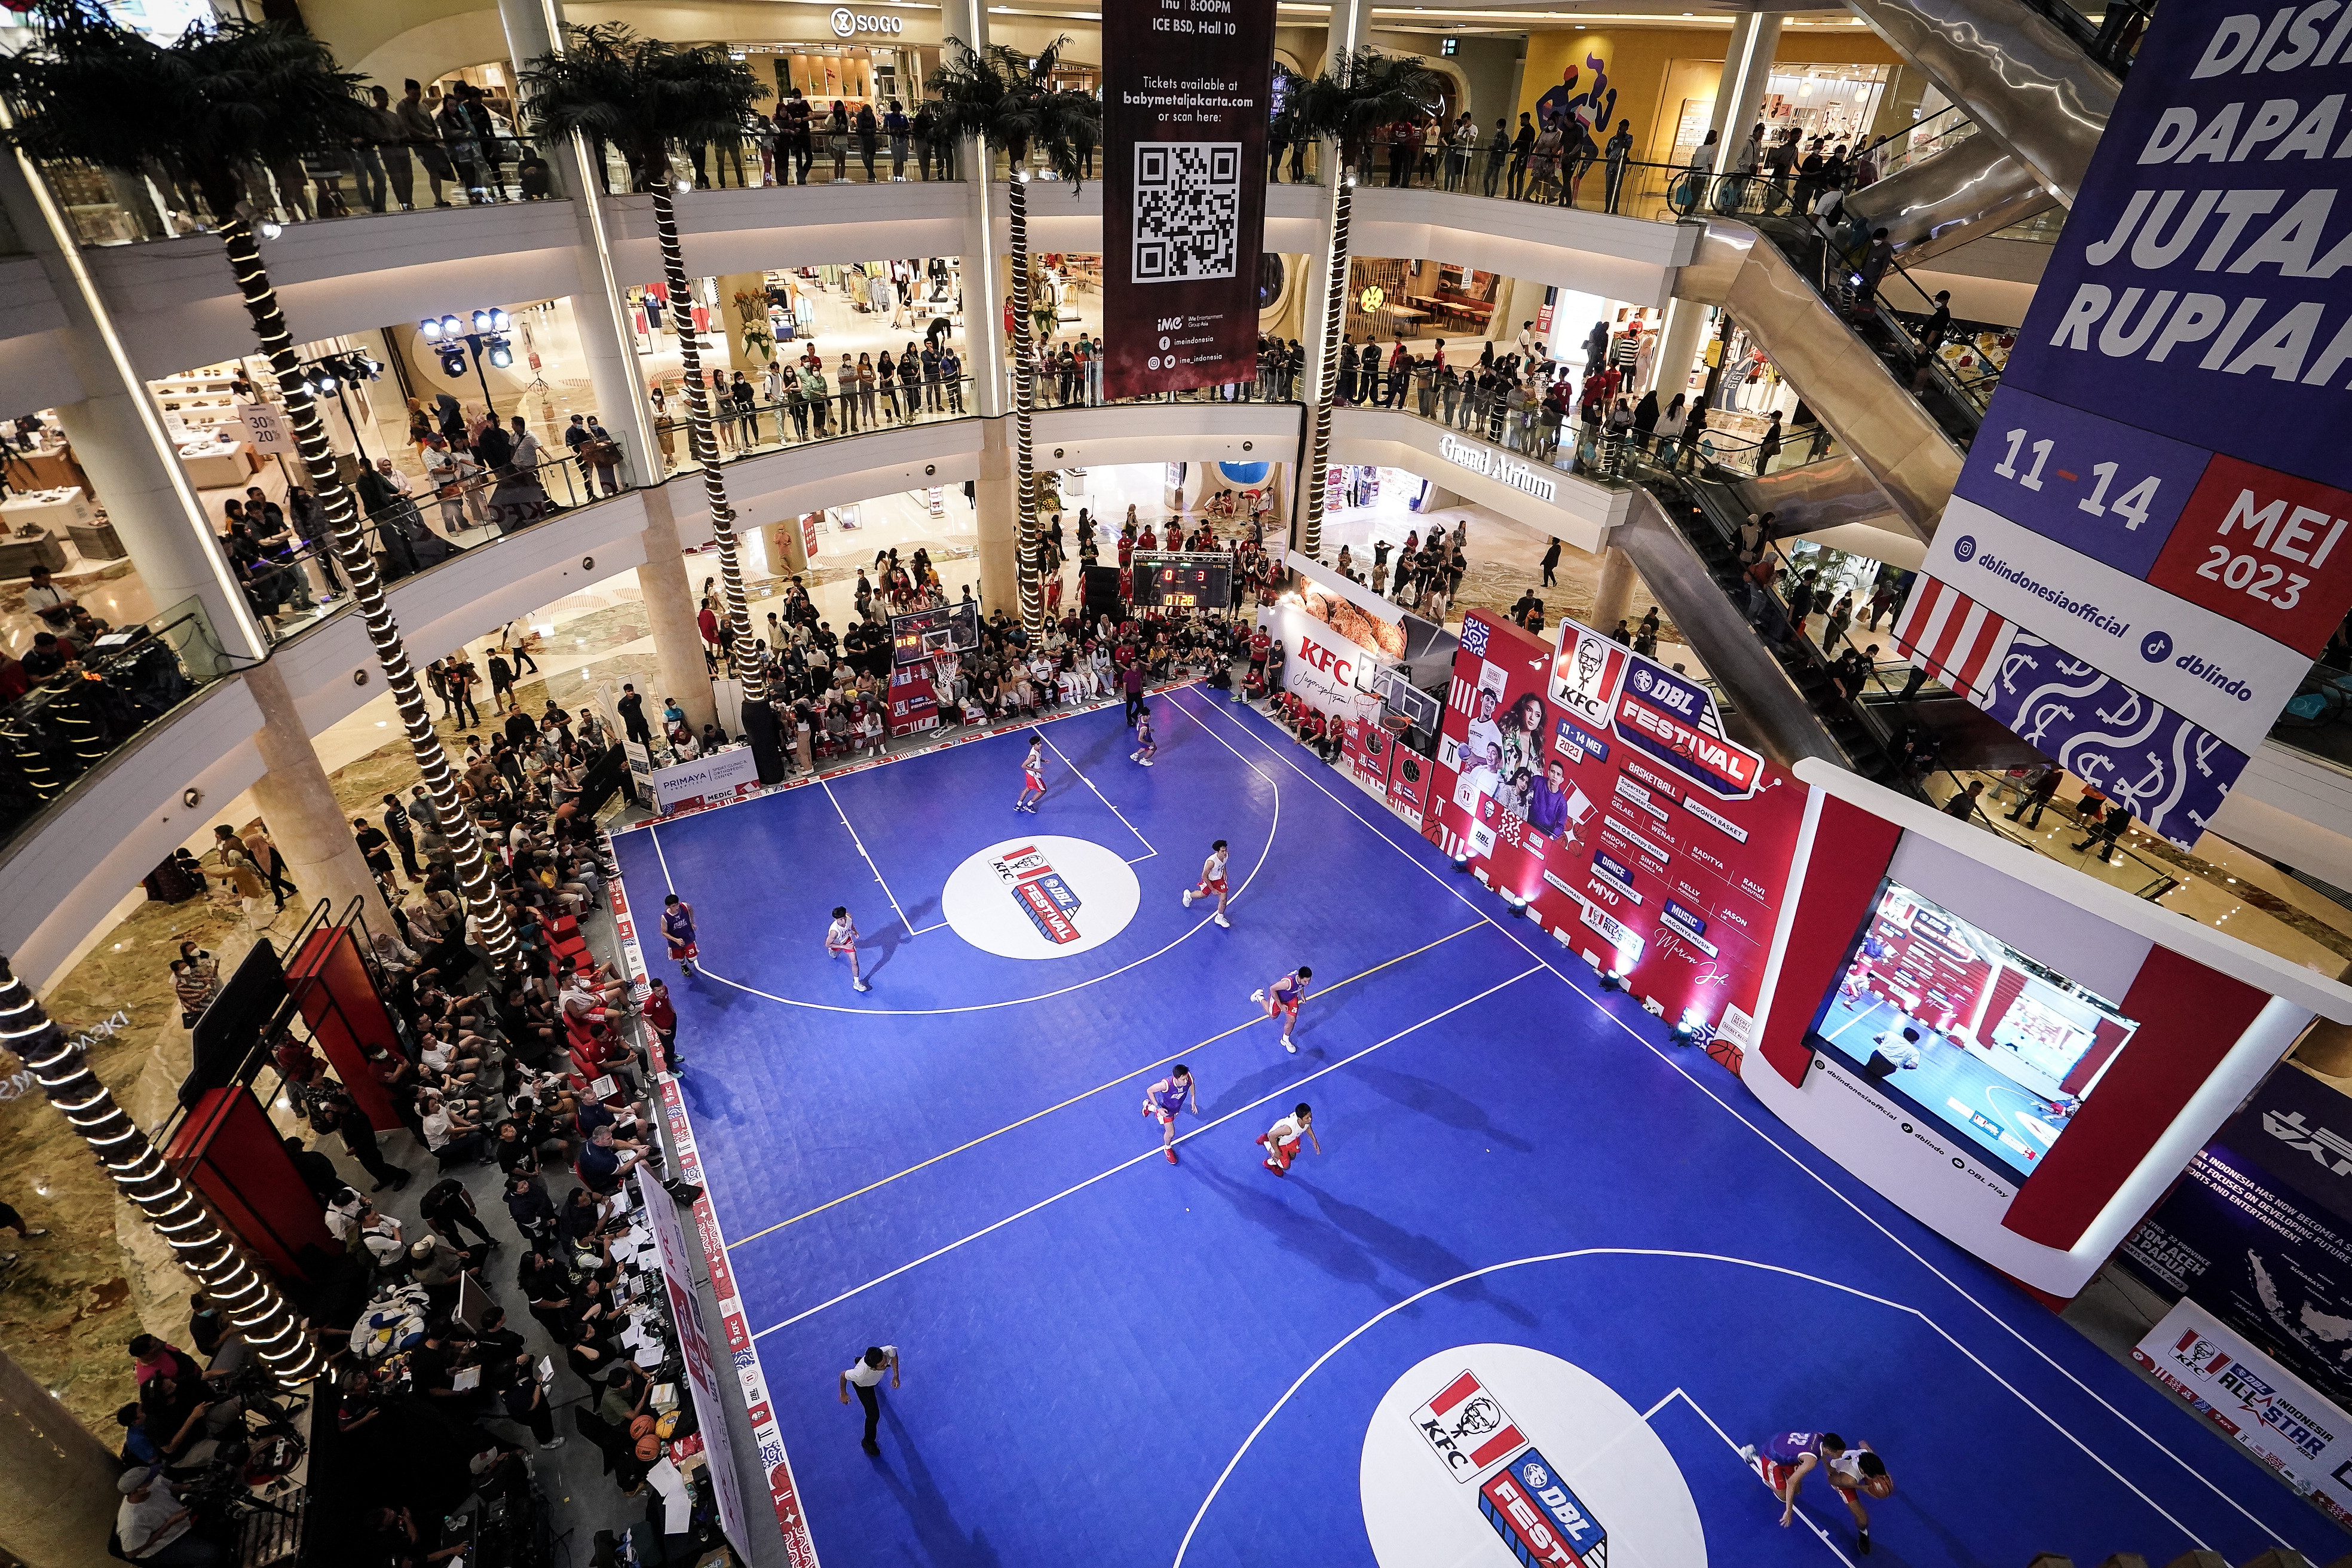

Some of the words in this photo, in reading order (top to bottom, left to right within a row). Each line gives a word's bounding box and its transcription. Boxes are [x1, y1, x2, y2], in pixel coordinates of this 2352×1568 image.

[1190, 0, 1231, 13] 8:00PM
[856, 14, 902, 33] SOGO
[1153, 18, 1170, 31] ICE
[1173, 19, 1195, 35] BSD,
[1199, 21, 1221, 34] Hall
[1224, 23, 1236, 35] 10
[2189, 0, 2352, 79] DISI
[1143, 76, 1177, 88] Tickets
[1181, 78, 1225, 90] available
[1229, 81, 1238, 91] at
[1123, 91, 1254, 109] babymetaljakarta.com
[1158, 113, 1169, 121] or
[1173, 113, 1192, 121] scan
[1197, 110, 1221, 122] here:
[2136, 93, 2352, 166] DAPA
[1174, 335, 1214, 345] imeindonesia
[1180, 353, 1222, 364] ime_indonesia
[1439, 434, 1492, 476] Grand
[1489, 454, 1557, 502] Atrium
[1993, 428, 2055, 492] 11
[2077, 461, 2163, 531] 14
[2216, 488, 2349, 570] MEI
[1198, 571, 1205, 581] 3
[2195, 544, 2311, 610] 2023
[1978, 552, 2131, 639] dblindonesiaofficial
[1298, 636, 1352, 687] KFC
[1487, 673, 1499, 683] RECIPE
[1489, 670, 1499, 679] SECRET
[2175, 654, 2252, 703] dblindo
[911, 699, 937, 710] FESTIVAL
[1558, 685, 1599, 716] KFC
[1649, 678, 1696, 716] DBL
[1559, 739, 1579, 758] 2023
[1561, 722, 1570, 736] 11
[1575, 731, 1585, 744] 14
[1585, 738, 1603, 755] MEI
[1622, 699, 1745, 782] FESTIVAL
[713, 764, 744, 776] ORTHOPEDIC
[714, 772, 733, 780] CENTER
[1628, 761, 1676, 798] BASKETBALL
[663, 772, 707, 789] PRIMAYA
[1621, 778, 1647, 797] Superstar
[708, 790, 733, 801] MEDIC
[1463, 790, 1470, 798] 11
[1613, 795, 1623, 804] SEAN
[1618, 786, 1647, 807] Almamater
[1646, 804, 1665, 819] Games
[1611, 800, 1636, 819] GELAEL
[1688, 802, 1718, 823] JAGONYA
[1717, 819, 1743, 837] BASKET
[1651, 824, 1676, 844] WENAS
[1652, 820, 1667, 831] DANIEL
[1475, 831, 1490, 845] DBL
[1601, 830, 1627, 849] ANDOVI
[1606, 839, 1618, 849] LOPEZ
[1609, 819, 1621, 829] 1on1
[1631, 834, 1647, 847] Crispy
[1647, 844, 1664, 858] Battle
[1601, 856, 1626, 878] DANCE
[1640, 854, 1664, 874] SINTYA
[1691, 852, 1702, 862] DIKA
[1692, 846, 1724, 870] RADITYA
[993, 861, 1014, 880] KFC
[1547, 874, 1581, 901] PENGUMUMAN
[1587, 878, 1619, 906] MIYU
[1595, 868, 1619, 889] JAGONYA
[1619, 884, 1638, 900] DANCE
[1679, 880, 1701, 897] KELLY
[1741, 884, 1765, 901] NASUTION
[1742, 877, 1766, 895] RALVI
[1049, 886, 1074, 906] DBL
[1677, 887, 1700, 904] PURWANTO
[1023, 883, 1071, 940] FESTIVAL
[1671, 904, 1698, 927] MUSIC
[1722, 908, 1748, 927] JASON
[1884, 910, 1903, 924] KFC
[1589, 919, 1599, 928] KFC
[1603, 922, 1615, 936] ALL
[1664, 917, 1691, 938] JAGONYA
[1692, 935, 1711, 951] MUSIK
[1913, 920, 1968, 956] FESTIVAL
[1654, 927, 1698, 964] Marion
[1723, 1024, 1738, 1036] SECRET
[1733, 1019, 1748, 1032] RECIPE
[1735, 1015, 1750, 1028] SECRET
[665, 1085, 674, 1097] KFC
[1827, 1070, 1898, 1121] dblindonesiaofficial
[1915, 1132, 1945, 1155] dblindo
[1967, 1168, 1986, 1184] DBL
[1987, 1181, 2010, 1198] Play
[2209, 1156, 2255, 1190] INDONESIA
[2254, 1182, 2275, 1202] HAS
[2274, 1198, 2299, 1216] NOW
[2296, 1212, 2337, 1241] BECOME
[2334, 1236, 2344, 1247] A
[2206, 1168, 2245, 1195] FOCUSES
[2244, 1192, 2258, 1204] ON
[2258, 1200, 2314, 1239] DEVELOPING
[2313, 1237, 2351, 1263] FUTURE
[2209, 1183, 2230, 1197] AND
[2228, 1196, 2304, 1246] ENTERTAINMENT.
[2140, 1239, 2186, 1278] PAPUA
[2166, 1247, 2206, 1277] ACEH
[2177, 1241, 2212, 1267] PROVINCE
[2290, 1265, 2325, 1291] SURABAYA
[2234, 1301, 2262, 1323] JAKARTA
[730, 1319, 740, 1336] KFC
[2175, 1353, 2206, 1376] KFC
[749, 1388, 758, 1401] DBL
[2244, 1375, 2267, 1394] DBL
[2218, 1371, 2257, 1408] ALL
[2262, 1405, 2327, 1457] STAR
[2276, 1397, 2335, 1443] INDONESIA
[2219, 1419, 2234, 1430] KFC
[1420, 1418, 1468, 1469] KFC
[2295, 1446, 2316, 1461] 2023
[1493, 1480, 1578, 1568] FEST
[1537, 1486, 1590, 1542] DBL
